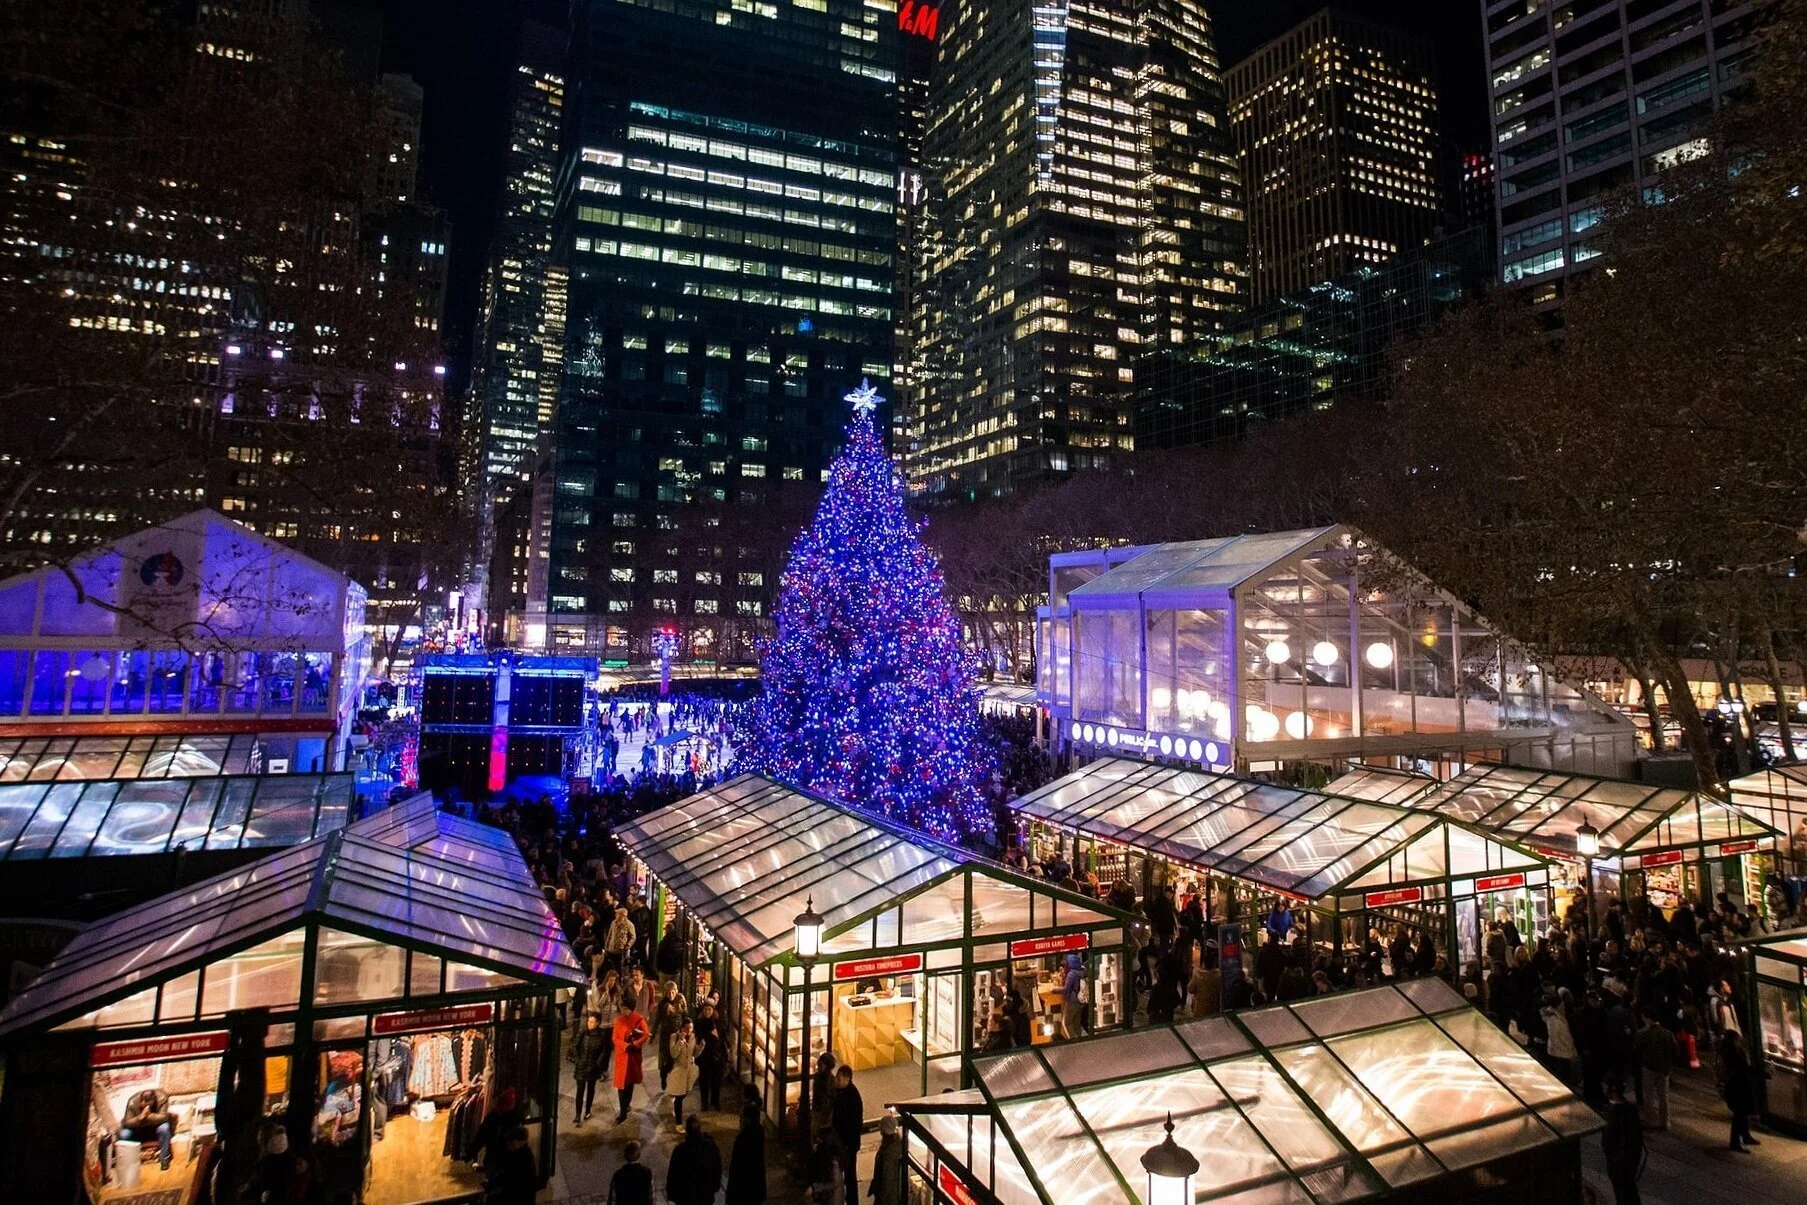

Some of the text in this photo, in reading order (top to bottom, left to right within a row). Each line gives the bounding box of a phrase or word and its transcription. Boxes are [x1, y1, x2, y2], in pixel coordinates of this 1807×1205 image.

[1051, 940, 1065, 948] GAMES
[459, 1010, 477, 1020] YORK
[109, 1038, 211, 1058] KASHMIR MOON NEW YORK
